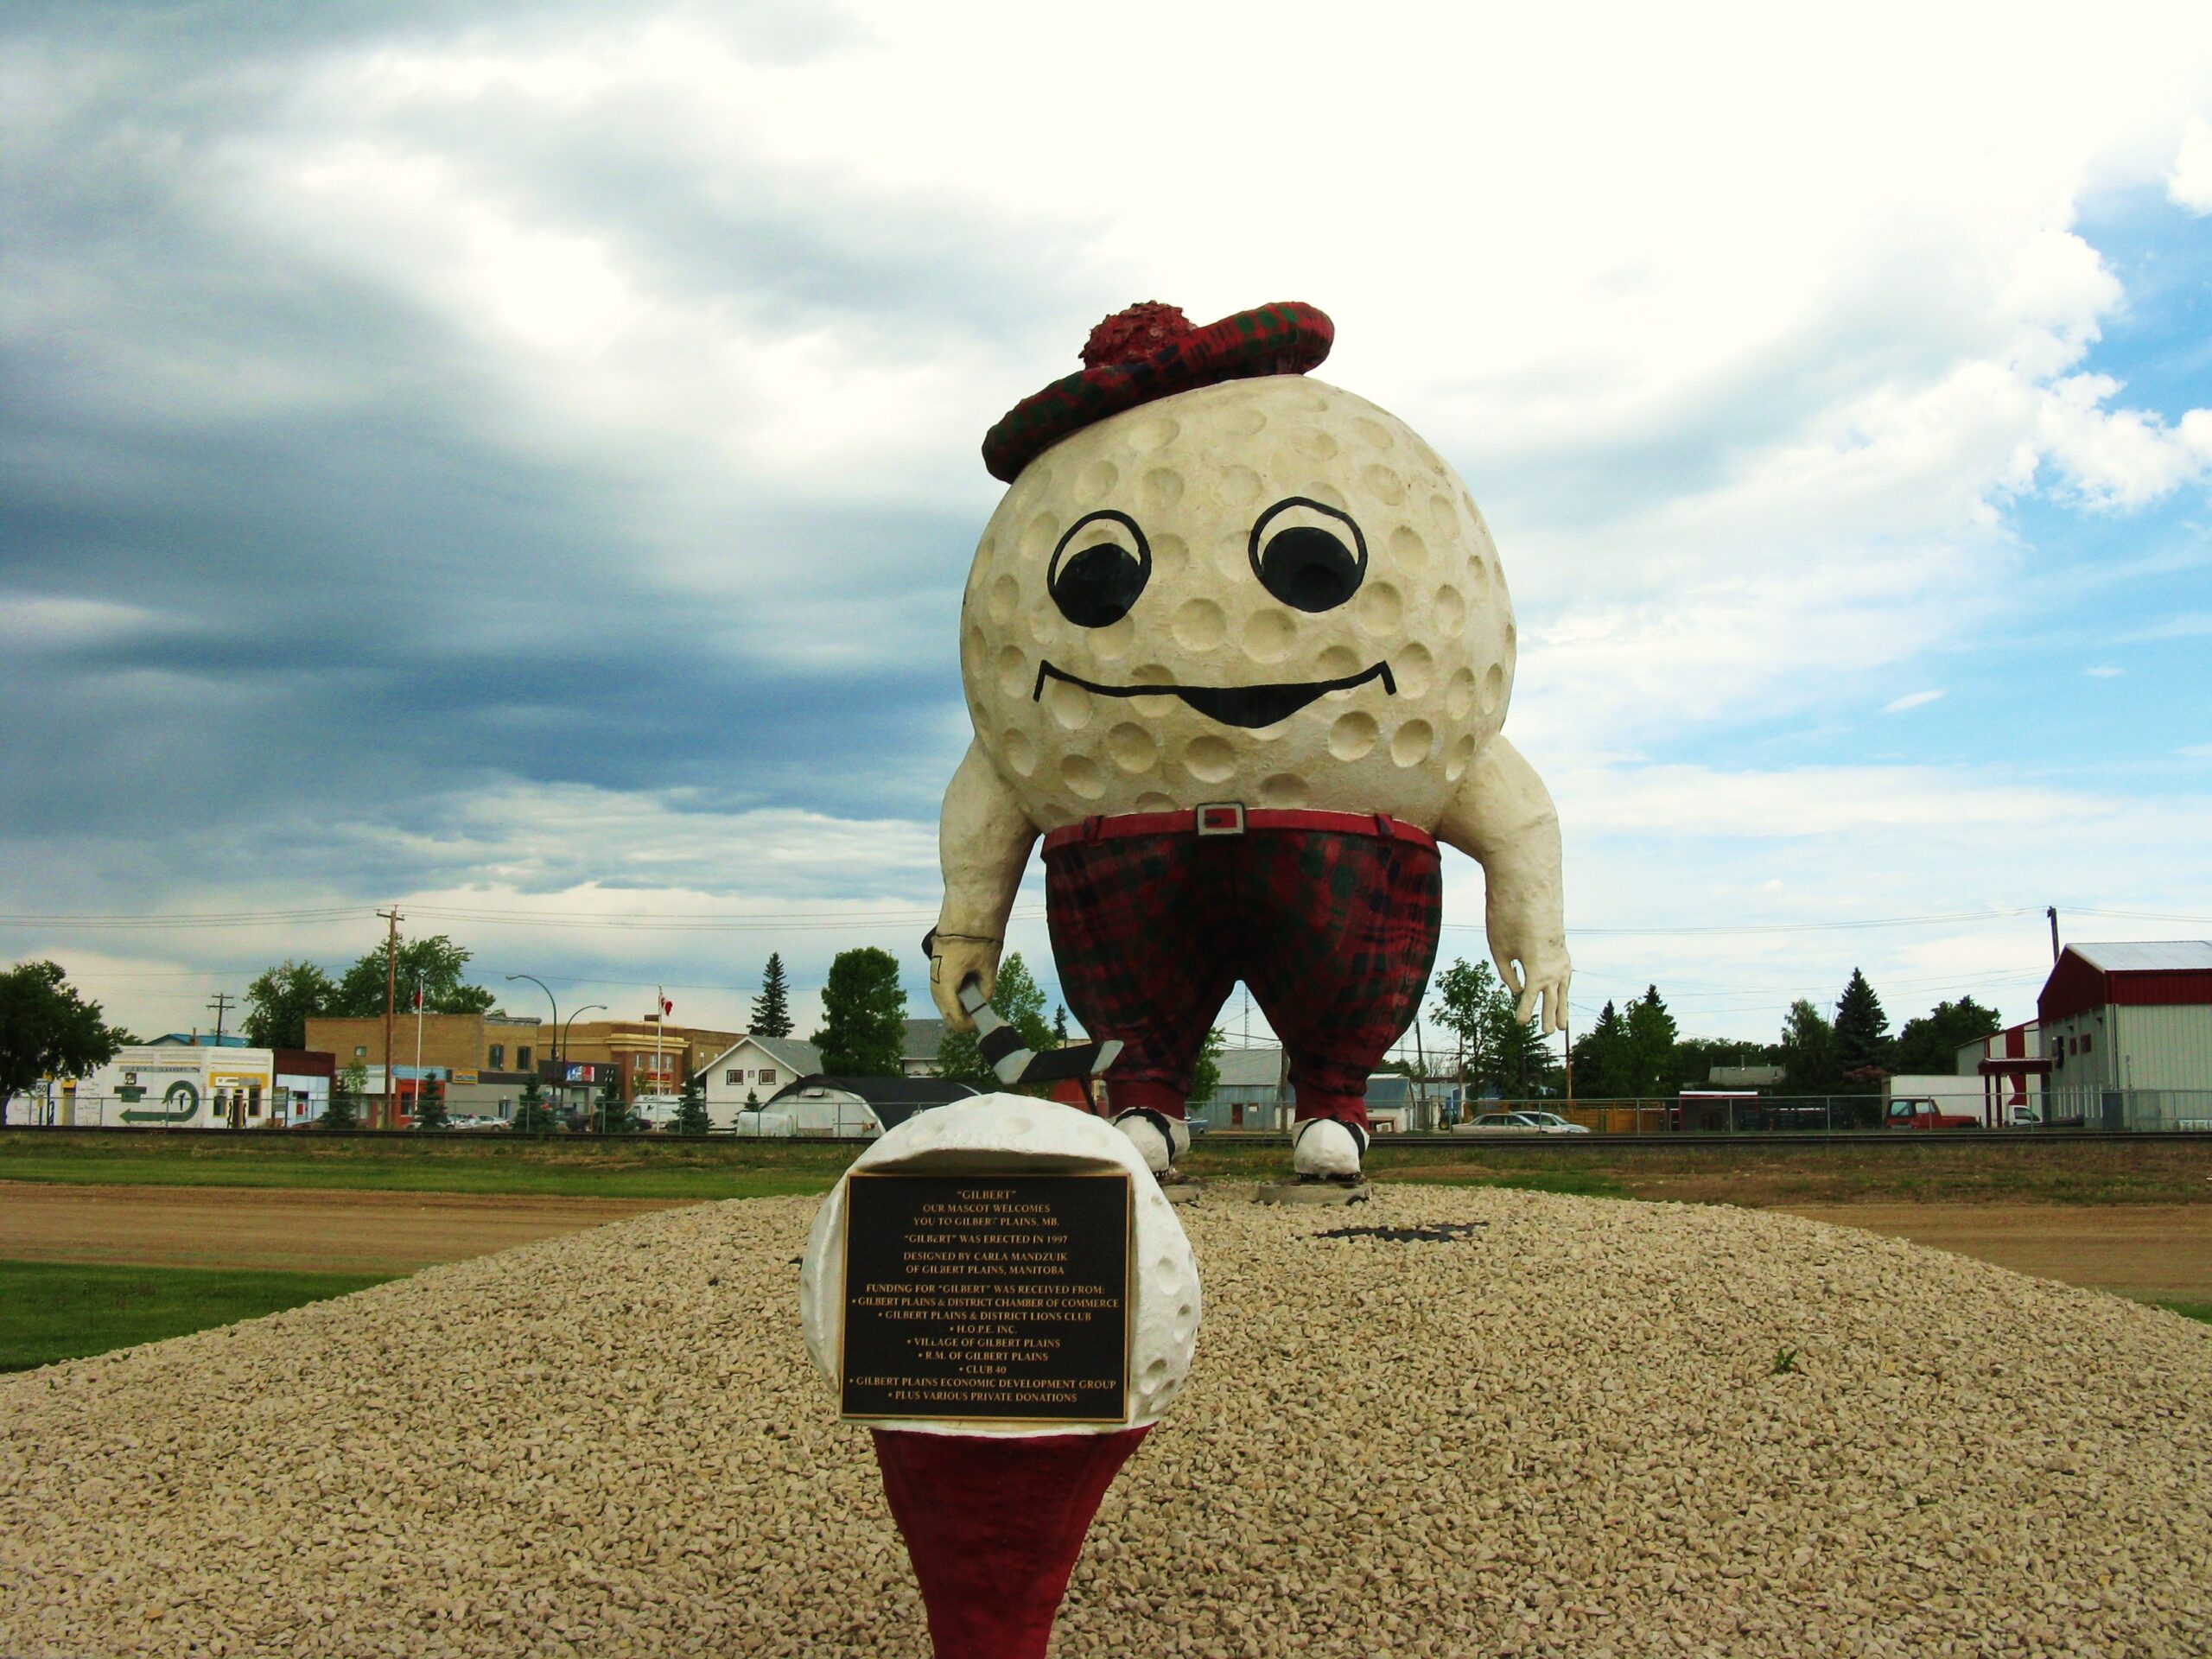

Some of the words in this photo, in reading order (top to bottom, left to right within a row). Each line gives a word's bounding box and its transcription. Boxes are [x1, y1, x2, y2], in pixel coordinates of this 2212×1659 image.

[36, 1084, 47, 1093] 50
[923, 1204, 944, 1213] OUR
[948, 1204, 989, 1213] MASCOT
[994, 1204, 1051, 1213] WELCOMES
[913, 1217, 936, 1226] YOU
[938, 1217, 952, 1226] TO
[955, 1217, 998, 1226] GILBERT
[1042, 1217, 1059, 1226] MB.
[959, 1235, 981, 1243] WAS
[983, 1235, 1030, 1243] ERECTED
[1033, 1235, 1044, 1243] IN
[1046, 1235, 1068, 1243] 1997
[903, 1252, 956, 1261] DESIGNED
[957, 1252, 971, 1261] BY
[974, 1252, 1008, 1261] CARLA
[1011, 1252, 1068, 1261] MANDZUIK
[906, 1265, 920, 1274] OF
[922, 1265, 964, 1274] GILBERT
[1009, 1265, 1065, 1275] MANITOBA
[866, 1284, 912, 1293] FUNDING
[915, 1284, 935, 1293] FOR
[994, 1284, 1015, 1294] WAS
[1018, 1285, 1070, 1294] RECEIVED
[1071, 1285, 1105, 1294] FROM:
[858, 1297, 899, 1306] GILBERT
[901, 1297, 936, 1306] PLAINS
[938, 1298, 945, 1306] &
[947, 1298, 993, 1307] DISTRICT
[995, 1299, 1044, 1307] CHAMBER
[1046, 1299, 1059, 1307] OF
[1061, 1299, 1119, 1308] COMMERCE
[886, 1311, 928, 1319] GILBERT
[931, 1311, 967, 1320] PLAINS
[969, 1312, 977, 1320] &
[980, 1312, 1027, 1320] DISTRICT
[1030, 1312, 1062, 1321] LIONS
[1064, 1312, 1091, 1321] CLUB
[957, 1325, 995, 1334] H.O.P.E.
[997, 1325, 1018, 1334] INC.
[914, 1338, 957, 1347] VILLAGE
[961, 1338, 976, 1347] OF
[977, 1338, 1021, 1347] GILBERT
[1024, 1338, 1060, 1348] PLAINS
[925, 1351, 947, 1361] R.M.
[949, 1351, 963, 1361] OF
[965, 1352, 1009, 1361] GILBERT
[1012, 1352, 1048, 1362] PLAINS
[966, 1365, 993, 1374] CLUB
[995, 1365, 1006, 1375] 40
[856, 1377, 900, 1386] GILBERT
[902, 1377, 938, 1387] PLAINS
[940, 1378, 995, 1388] ECONOMIC
[998, 1379, 1077, 1389] DEVELOPMENT
[1079, 1380, 1116, 1389] GROUP
[895, 1391, 921, 1400] PLUS
[924, 1391, 969, 1401] VARIOUS
[970, 1392, 1014, 1401] PRIVATE
[1015, 1393, 1077, 1402] DONATIONS
